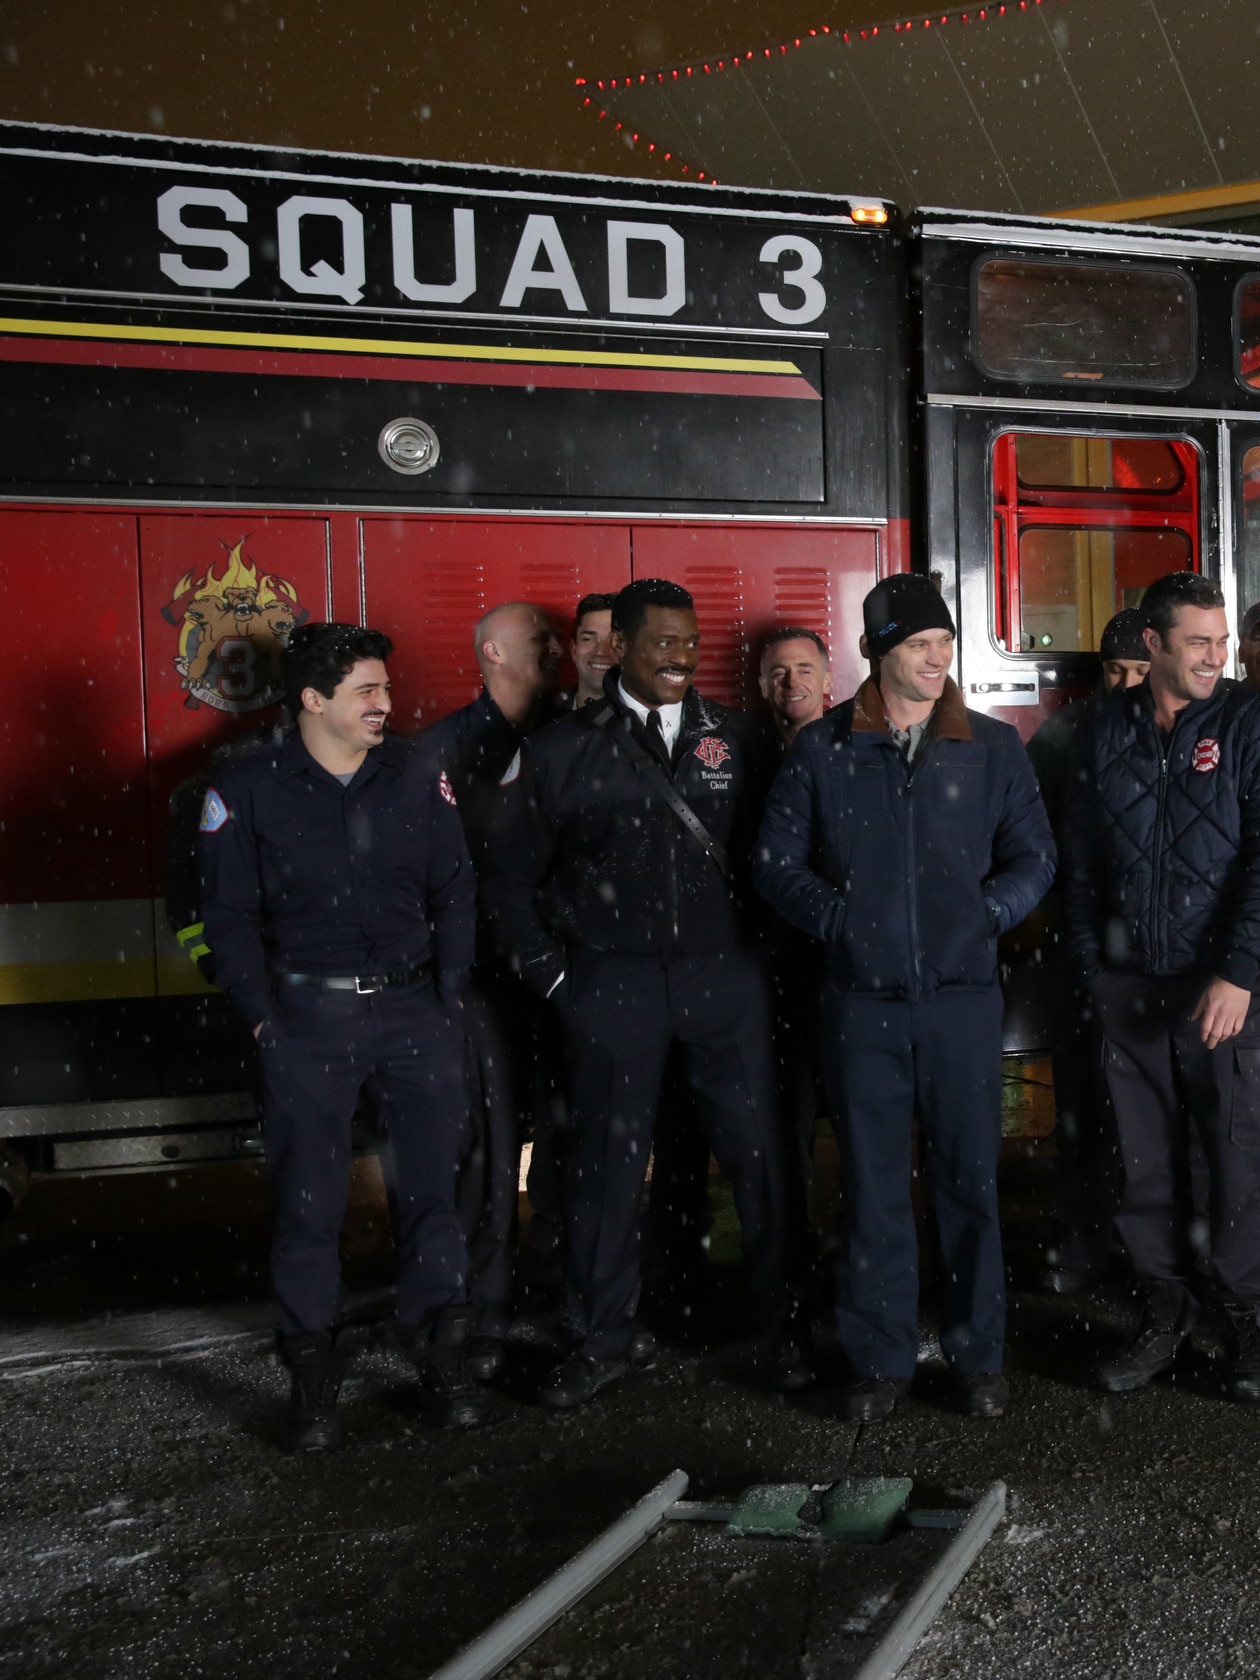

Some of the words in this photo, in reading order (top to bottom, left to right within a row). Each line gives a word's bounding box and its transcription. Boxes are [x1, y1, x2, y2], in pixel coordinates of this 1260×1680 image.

[157, 186, 686, 317] SQUAD
[758, 234, 827, 325] 3
[219, 638, 255, 698] 3
[201, 691, 230, 709] BORN
[701, 770, 733, 780] Battalion
[710, 781, 728, 790] Chief
